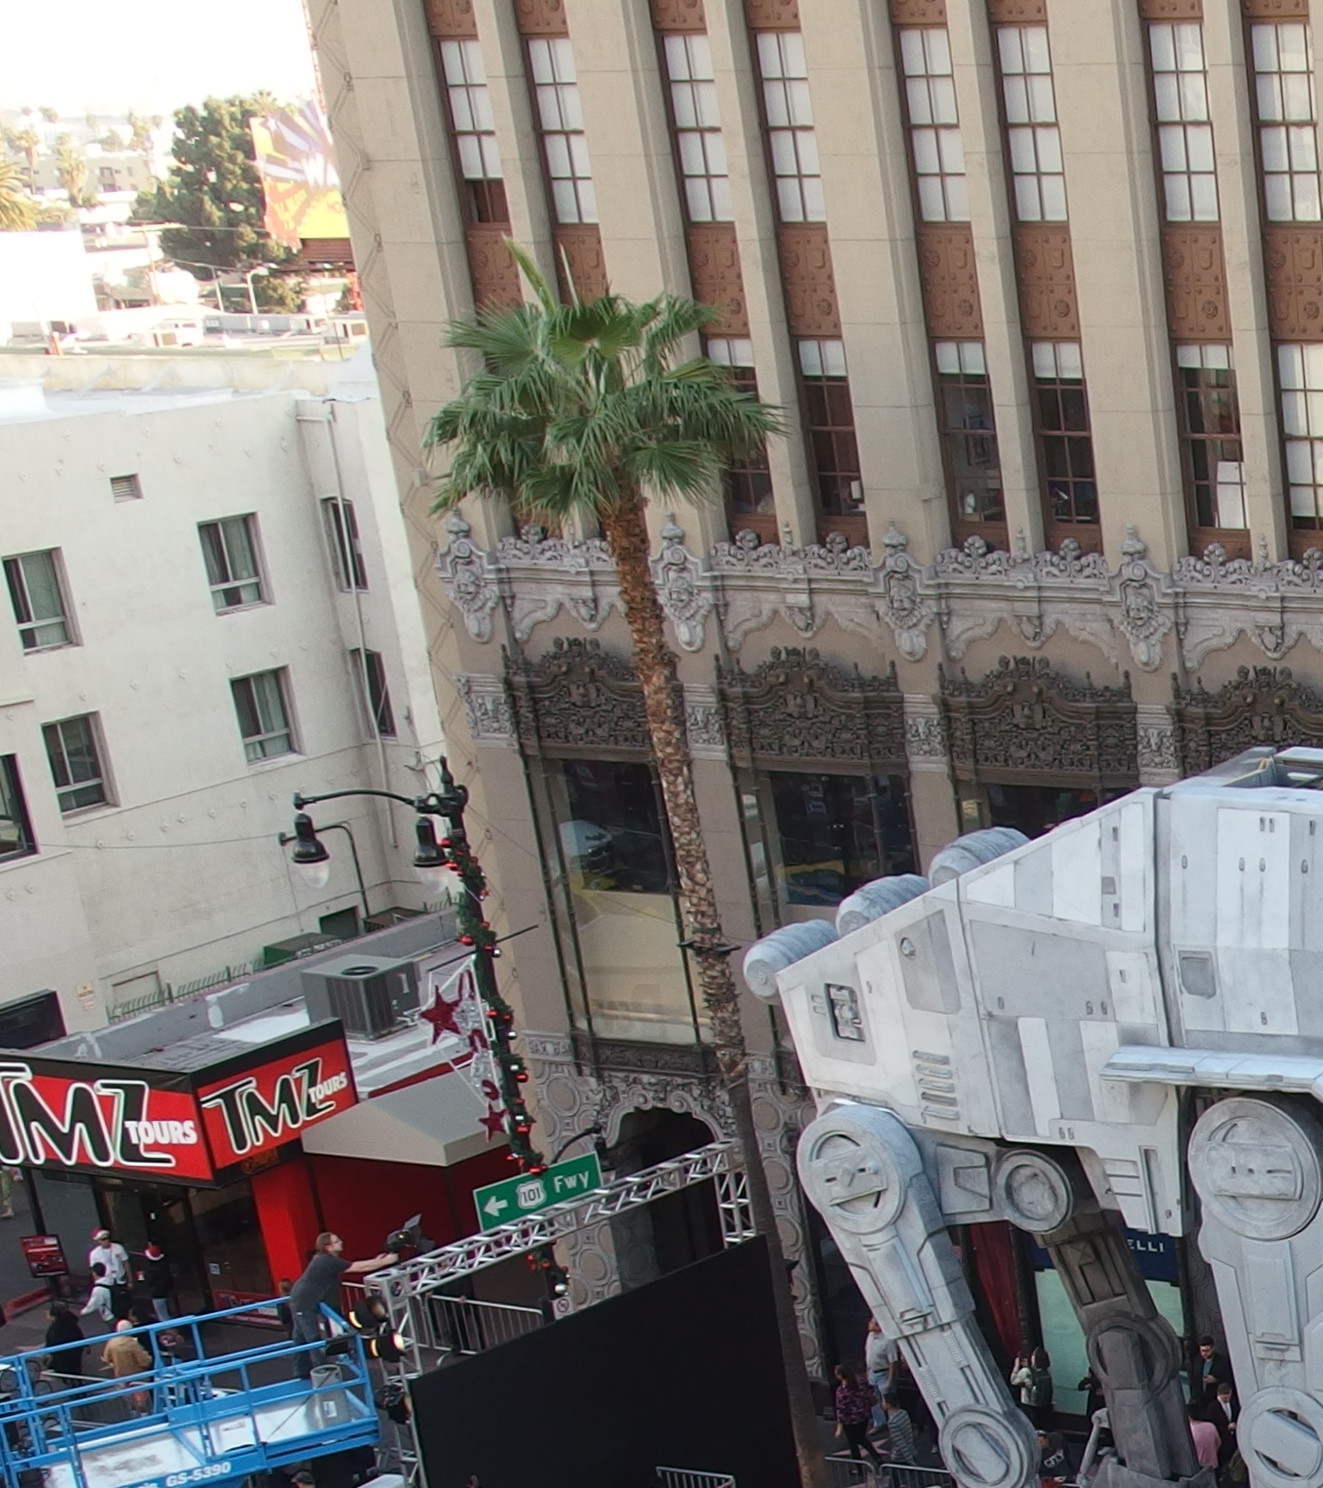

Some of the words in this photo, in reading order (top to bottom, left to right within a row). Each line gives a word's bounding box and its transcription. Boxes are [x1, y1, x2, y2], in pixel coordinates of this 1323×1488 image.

[201, 1056, 337, 1155] TMZ
[308, 1072, 348, 1103] TOURS
[124, 1120, 198, 1144] TOURS
[521, 1187, 541, 1203] 101
[553, 1171, 590, 1193] Fwy
